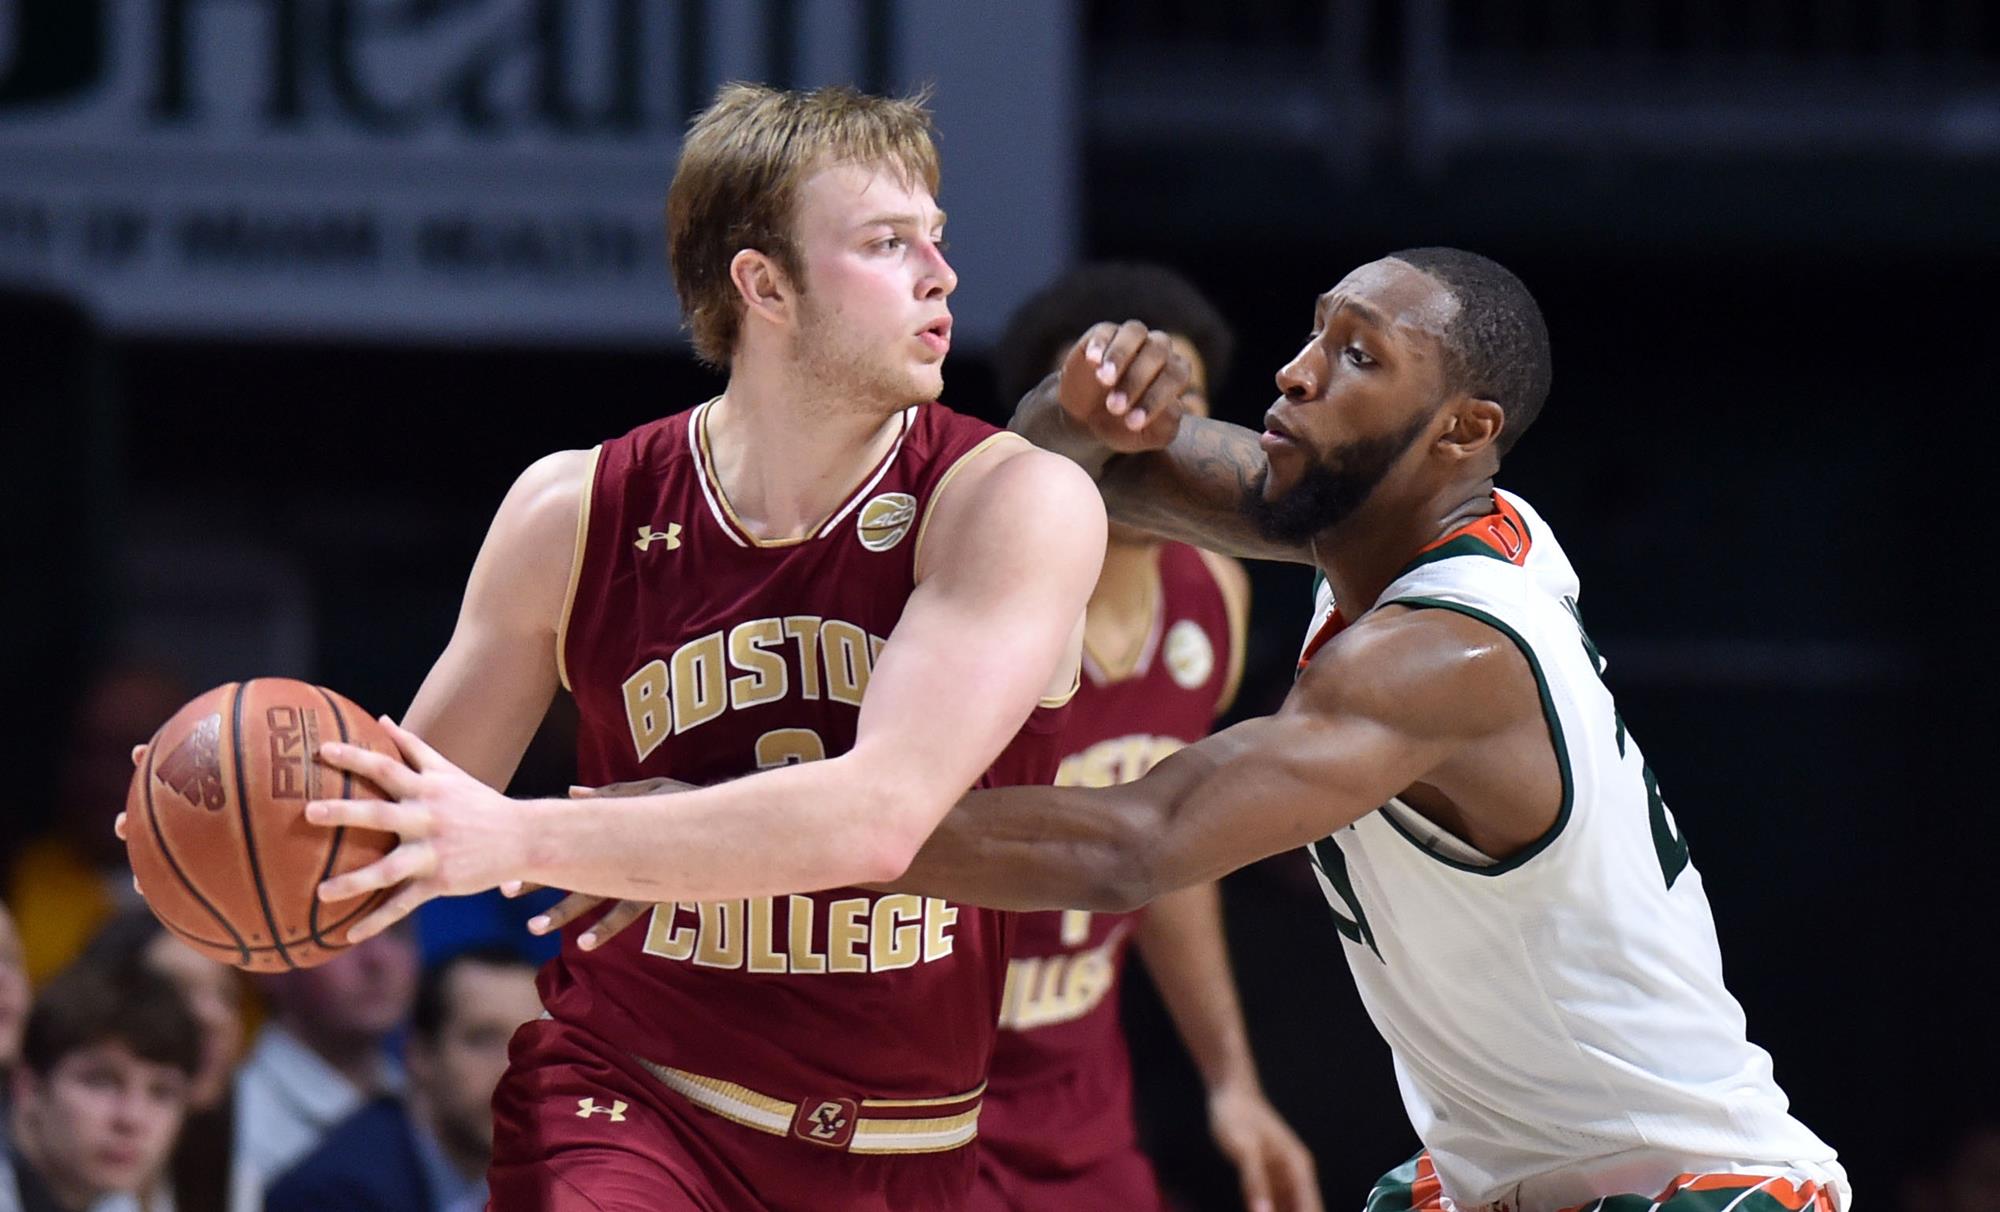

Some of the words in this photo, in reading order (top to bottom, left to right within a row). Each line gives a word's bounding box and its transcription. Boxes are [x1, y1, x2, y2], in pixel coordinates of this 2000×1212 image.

[622, 615, 887, 763] BOSTO
[266, 704, 304, 800] PRO
[642, 893, 958, 974] COLLEGE
